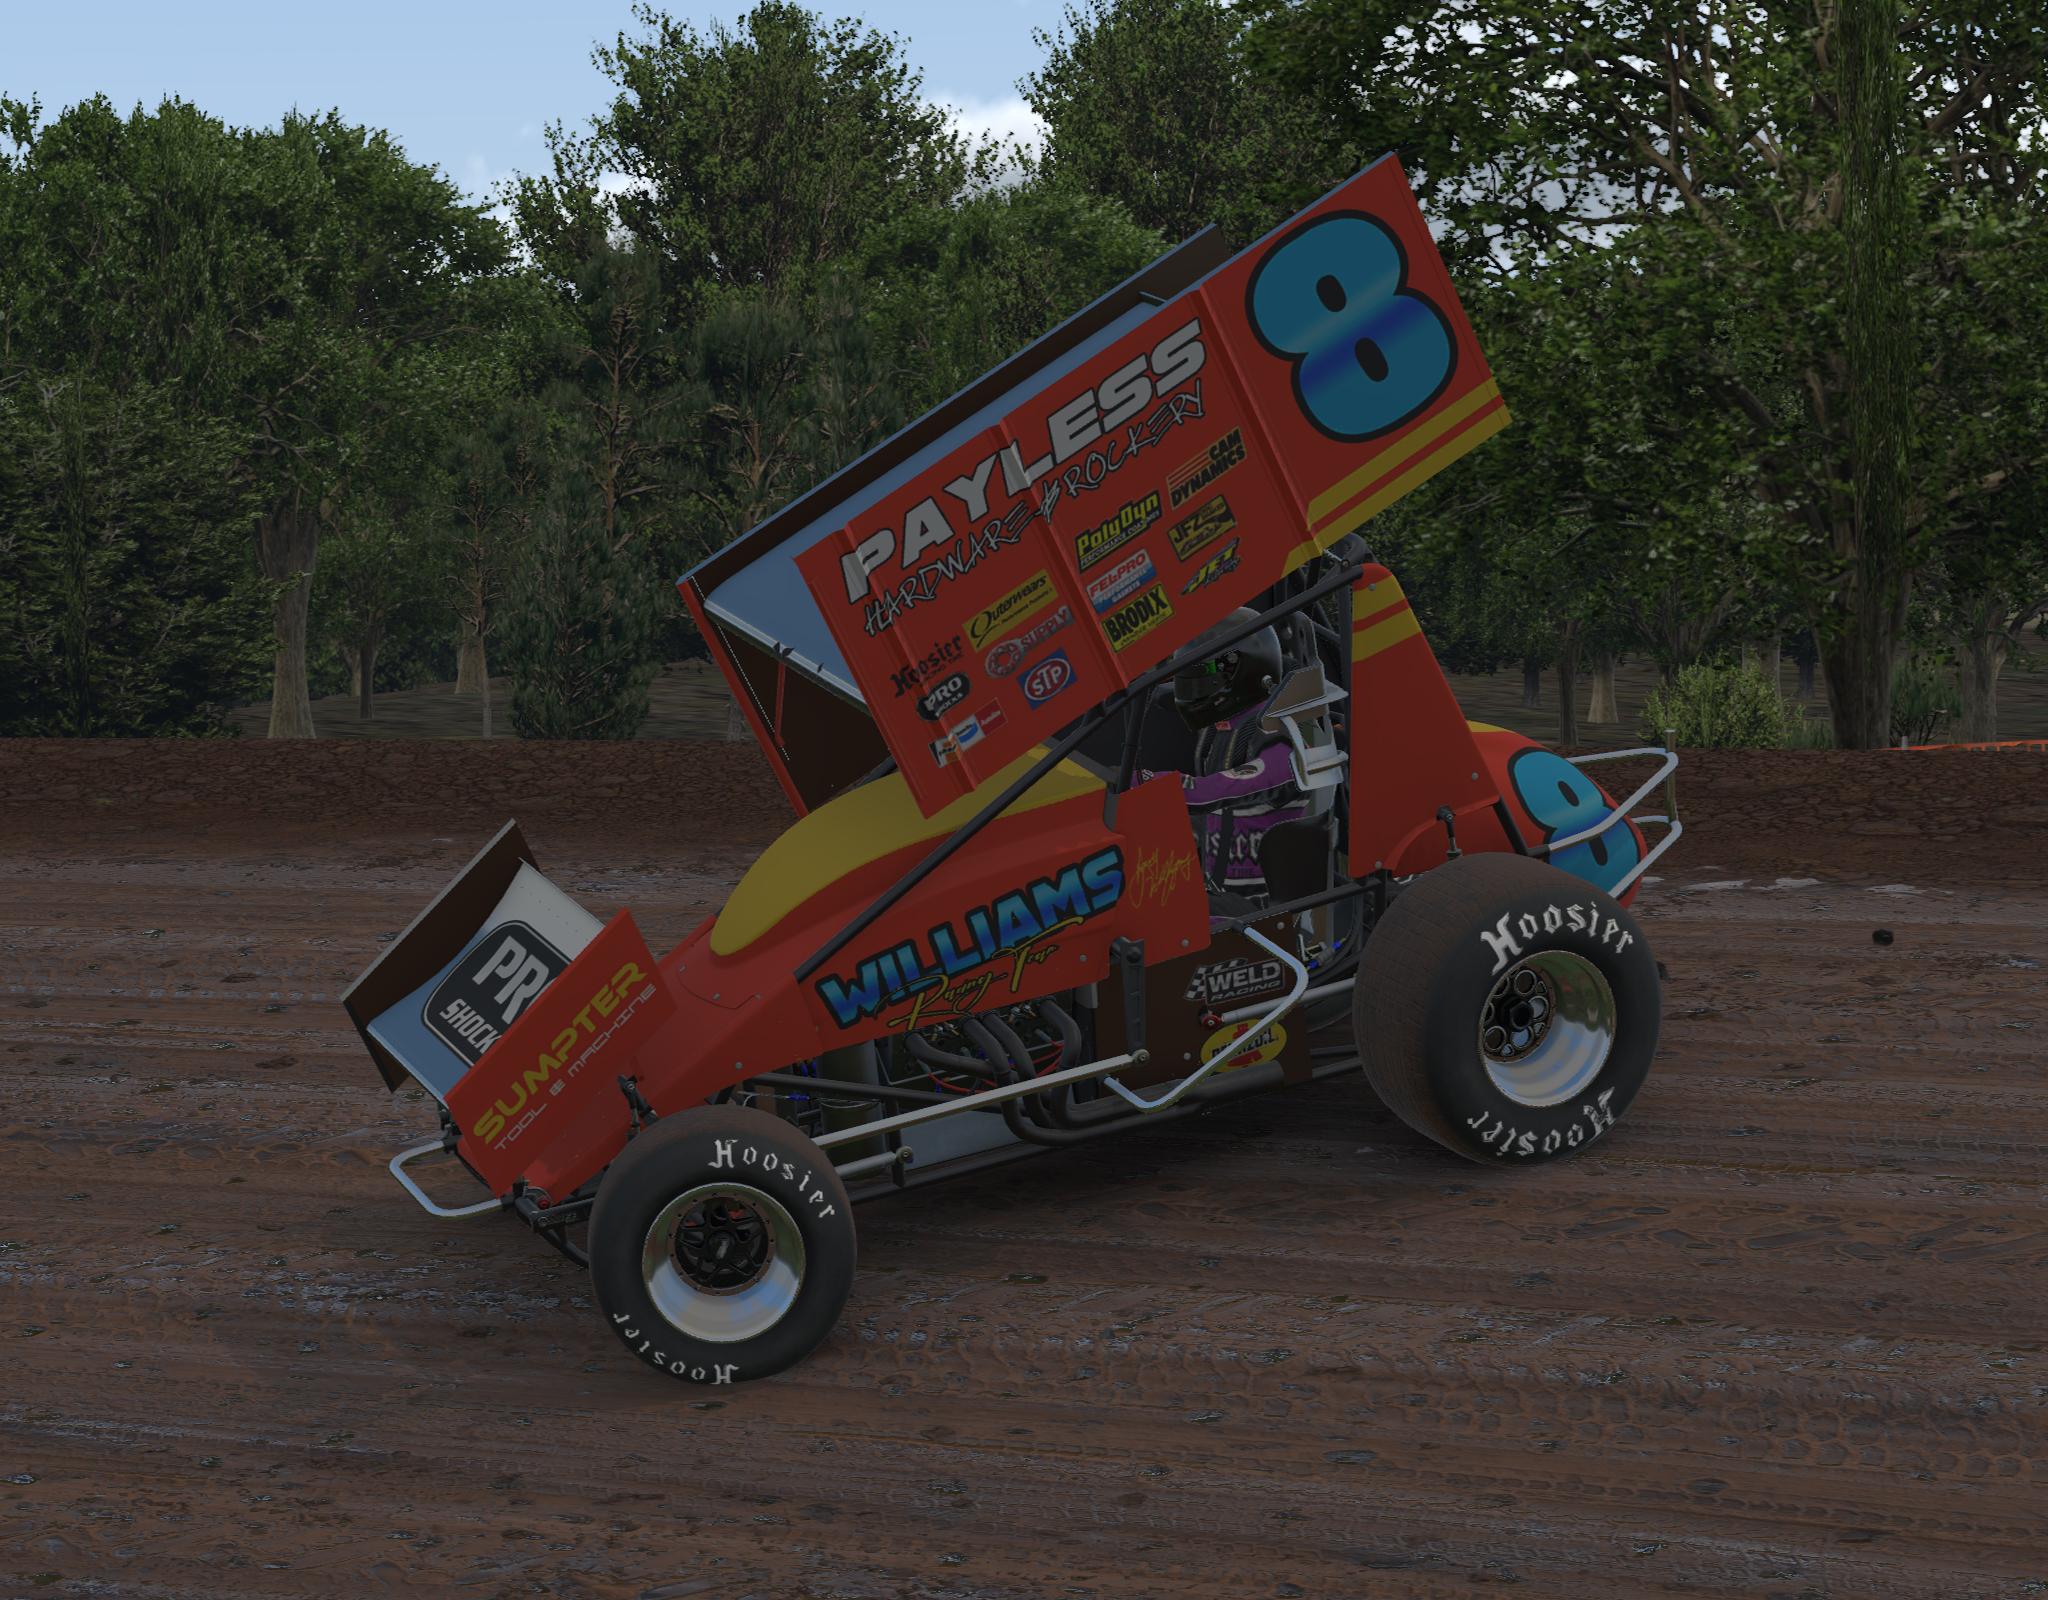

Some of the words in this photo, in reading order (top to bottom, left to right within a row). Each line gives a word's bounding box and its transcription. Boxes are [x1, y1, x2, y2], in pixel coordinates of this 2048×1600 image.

[1245, 209, 1458, 443] 8
[839, 317, 1206, 604] PAYLESS
[1170, 445, 1246, 507] DYNAMICS
[1208, 428, 1242, 461] CAM
[864, 501, 1034, 636] HARDWARE
[1063, 378, 1205, 499] ROCKERY
[1076, 492, 1160, 557] PolyDyn
[1173, 514, 1202, 543] JFZ
[970, 574, 1048, 648] Outerwears
[1104, 588, 1168, 643] BRODIX
[890, 635, 961, 697] Hoosier
[924, 675, 963, 711] PRO
[1032, 666, 1063, 696] STP
[1507, 746, 1642, 899] 8
[815, 844, 1126, 1030] WILLIAMS
[1479, 901, 1635, 977] Hoosier
[472, 935, 558, 1025] PR
[1207, 961, 1281, 993] WELD
[1210, 979, 1281, 1001] RACING
[472, 961, 648, 1145] SUMPTER
[493, 1103, 548, 1151] TOOL
[567, 983, 656, 1078] MACHINE
[1466, 1085, 1618, 1158] Hoosier
[707, 1138, 836, 1219] Hoosier
[613, 1311, 741, 1386] Hoosier
